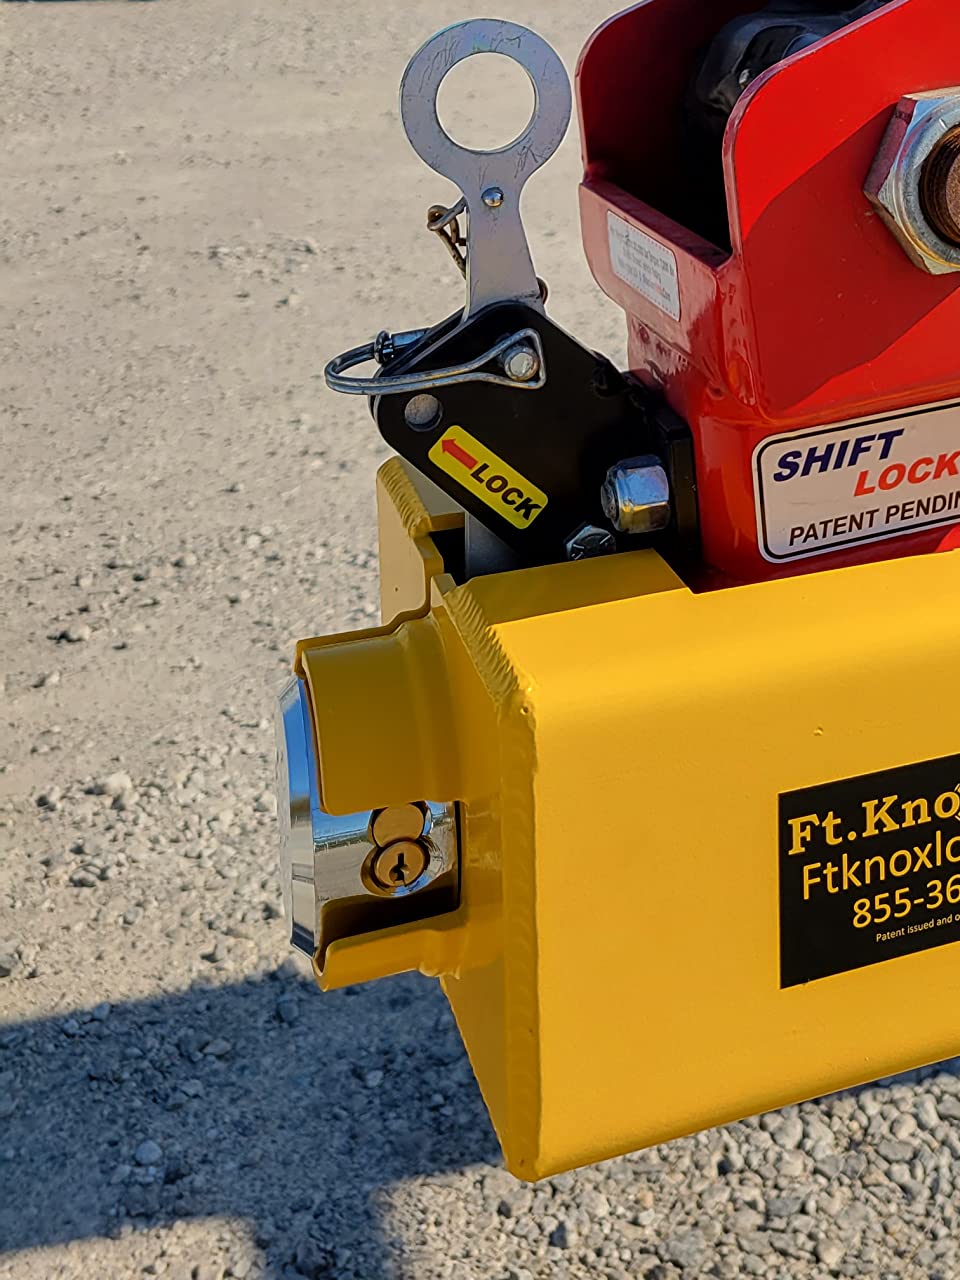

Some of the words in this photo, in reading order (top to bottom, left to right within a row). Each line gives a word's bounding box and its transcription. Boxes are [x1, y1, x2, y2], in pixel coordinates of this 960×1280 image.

[773, 428, 905, 483] SHIFT
[469, 462, 543, 521] LOCK
[788, 508, 880, 547] PATENT
[875, 927, 905, 943] Patent
[906, 918, 935, 935] issued
[936, 913, 953, 928] and
